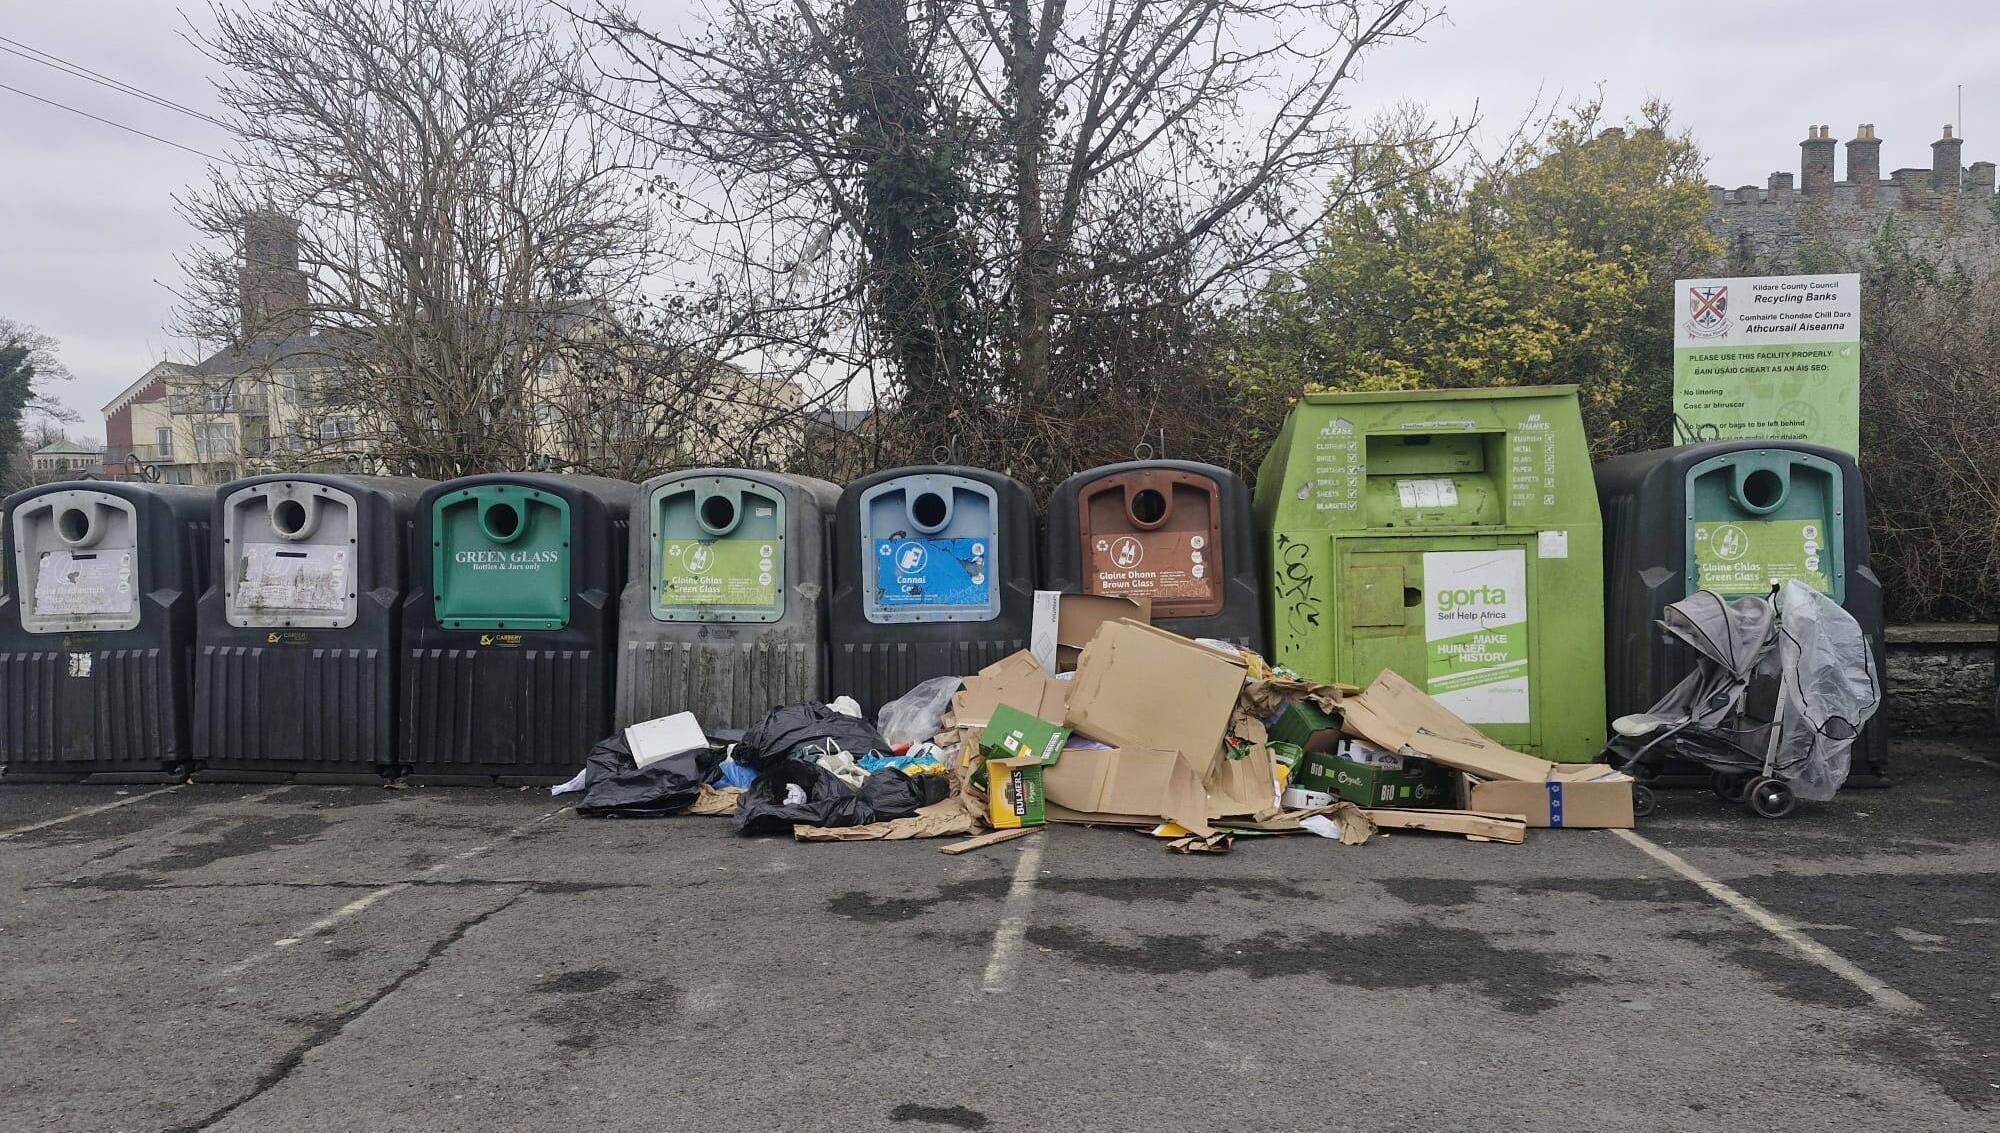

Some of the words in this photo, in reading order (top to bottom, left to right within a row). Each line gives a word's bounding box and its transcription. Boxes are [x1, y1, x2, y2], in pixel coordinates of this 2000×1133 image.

[1781, 283, 1807, 291] County
[1754, 293, 1803, 304] Recycling
[1806, 292, 1837, 301] Banks
[1814, 311, 1832, 319] Chill
[1739, 366, 1769, 374] CHEART
[1771, 365, 1782, 373] AS
[1528, 413, 1541, 421] NO
[1518, 422, 1551, 431] THANKS
[1728, 422, 1746, 430] bags
[455, 551, 507, 563] GREEN
[510, 550, 559, 563] GLASS
[525, 563, 541, 571] only
[1703, 562, 1732, 572] Gloine
[1100, 571, 1127, 580] Gloine
[1128, 570, 1157, 579] Dhonn
[1704, 572, 1732, 581] Green
[1734, 572, 1760, 581] Glass
[699, 585, 721, 593] Glass
[1102, 581, 1130, 589] Brown
[1131, 580, 1154, 588] Glass
[1437, 585, 1506, 611] gorta
[1438, 611, 1455, 620] Self
[1457, 611, 1478, 621] Help
[1480, 611, 1507, 619] Africa
[1473, 634, 1508, 644] MAKE
[1437, 643, 1486, 654] HUNGER
[1459, 652, 1508, 663] HISTORY
[1013, 771, 1025, 815] BULMERS
